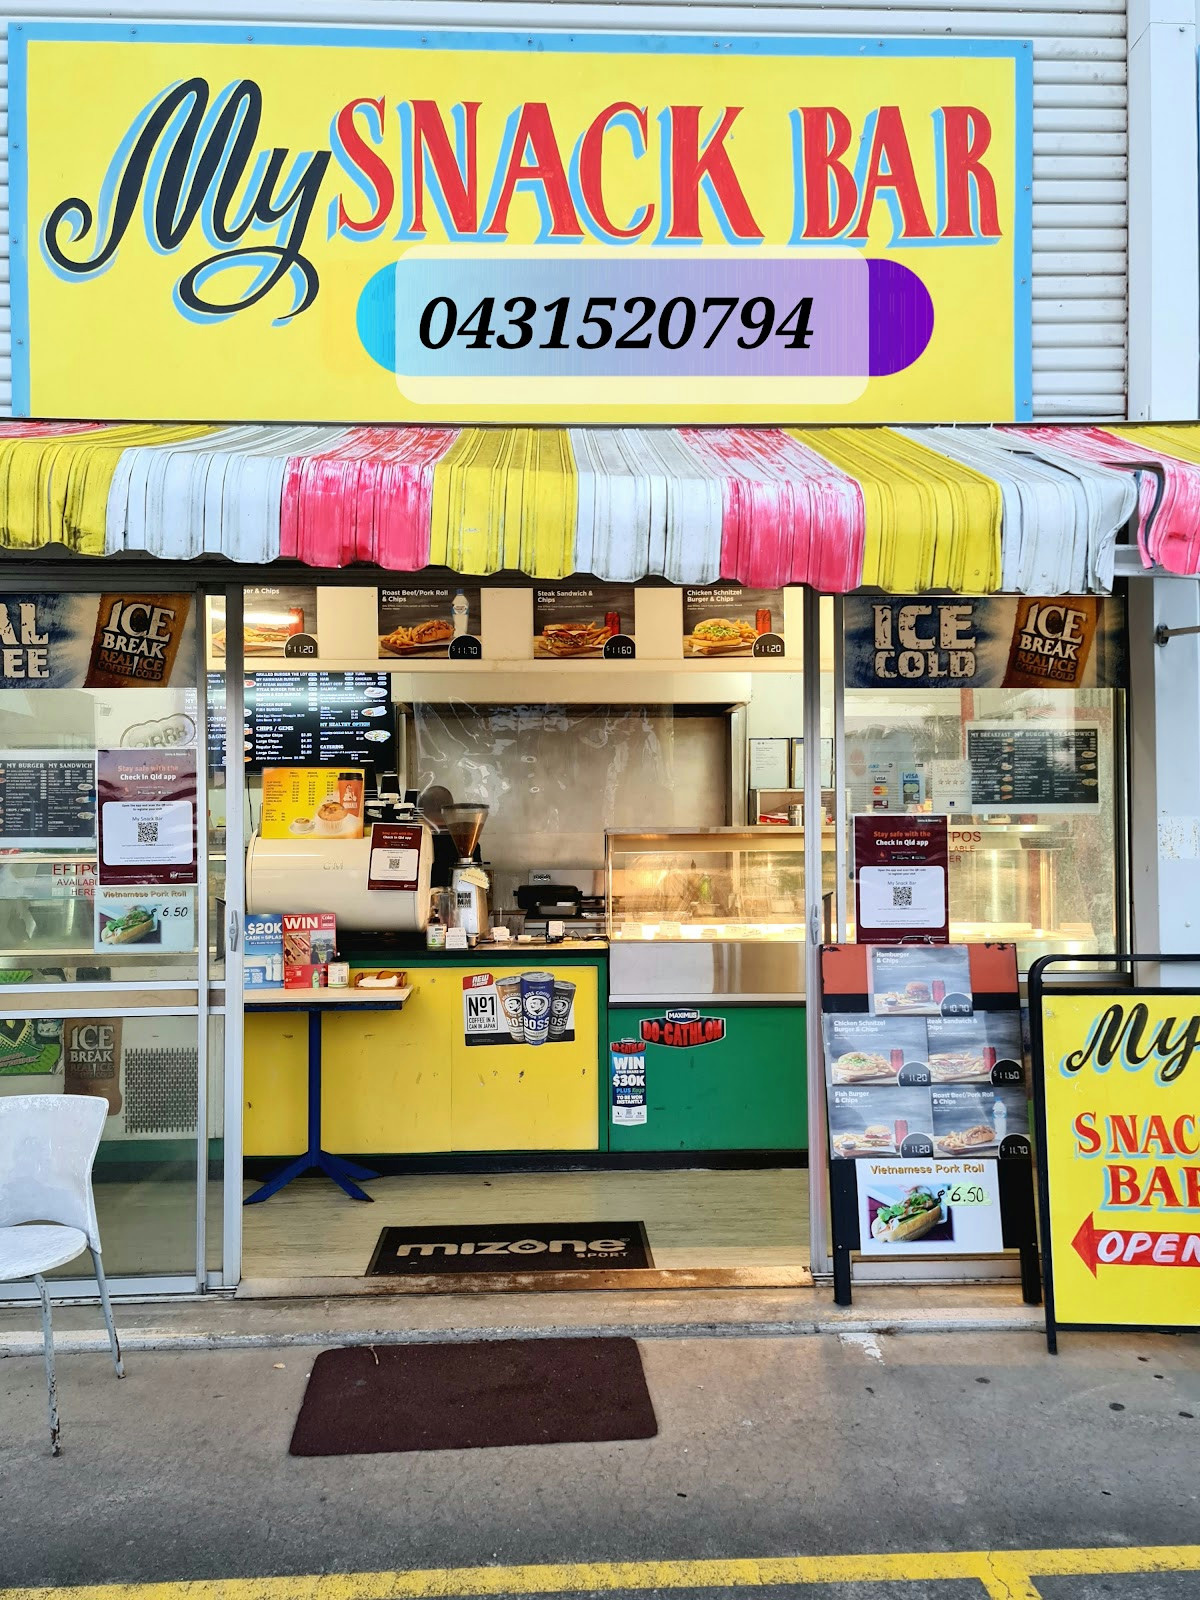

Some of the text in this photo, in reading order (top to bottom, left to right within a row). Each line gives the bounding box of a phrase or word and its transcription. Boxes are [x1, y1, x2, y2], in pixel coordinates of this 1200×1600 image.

[45, 77, 1004, 319] My SNACK BAR
[103, 600, 175, 642] ICE
[872, 605, 976, 650] ICE
[1022, 604, 1086, 644] ICE
[100, 632, 166, 659] BREAK
[1018, 634, 1080, 660] BREAK
[100, 650, 164, 673] REAL ICE
[874, 650, 976, 678] COLD
[1018, 652, 1076, 673] REAL ICE
[135, 668, 162, 680] COLD
[1051, 670, 1074, 682] COLD
[162, 906, 188, 917] 6.50
[248, 922, 282, 935] $20K
[284, 917, 318, 929] WIN
[524, 1017, 549, 1029] BOSS
[643, 1020, 722, 1046] DO-CATHLON
[70, 1025, 114, 1050] ICE
[1066, 1002, 1200, 1082] My
[70, 1051, 113, 1062] BREAK
[614, 1056, 644, 1069] WIN
[613, 1074, 645, 1087] $30K
[870, 1164, 984, 1174] Vietnamese Pork Roll
[951, 1187, 984, 1202] 6.50
[396, 1239, 626, 1256] mizone
[1097, 1231, 1200, 1263] OPEN
